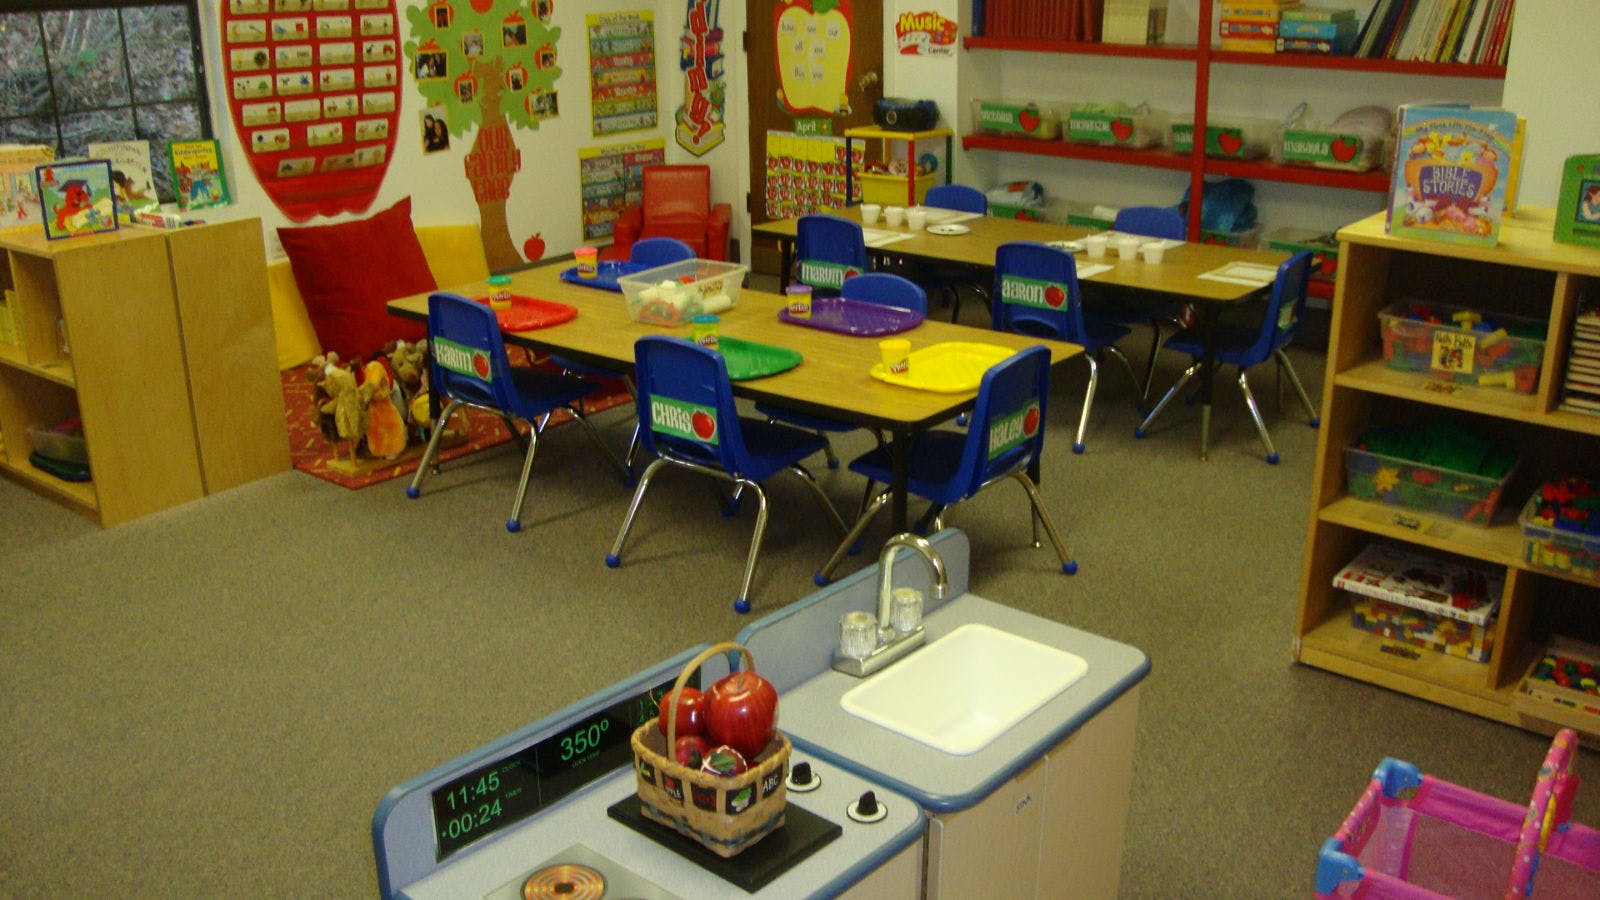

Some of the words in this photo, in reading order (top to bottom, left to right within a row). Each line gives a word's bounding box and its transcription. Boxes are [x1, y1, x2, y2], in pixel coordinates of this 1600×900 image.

[899, 11, 945, 32] Music
[797, 122, 817, 134] April
[1432, 166, 1470, 182] BIBLE
[1423, 178, 1474, 198] STORIES
[447, 771, 500, 810] 11:45
[762, 773, 779, 793] ABC
[448, 799, 502, 839] 00:24
